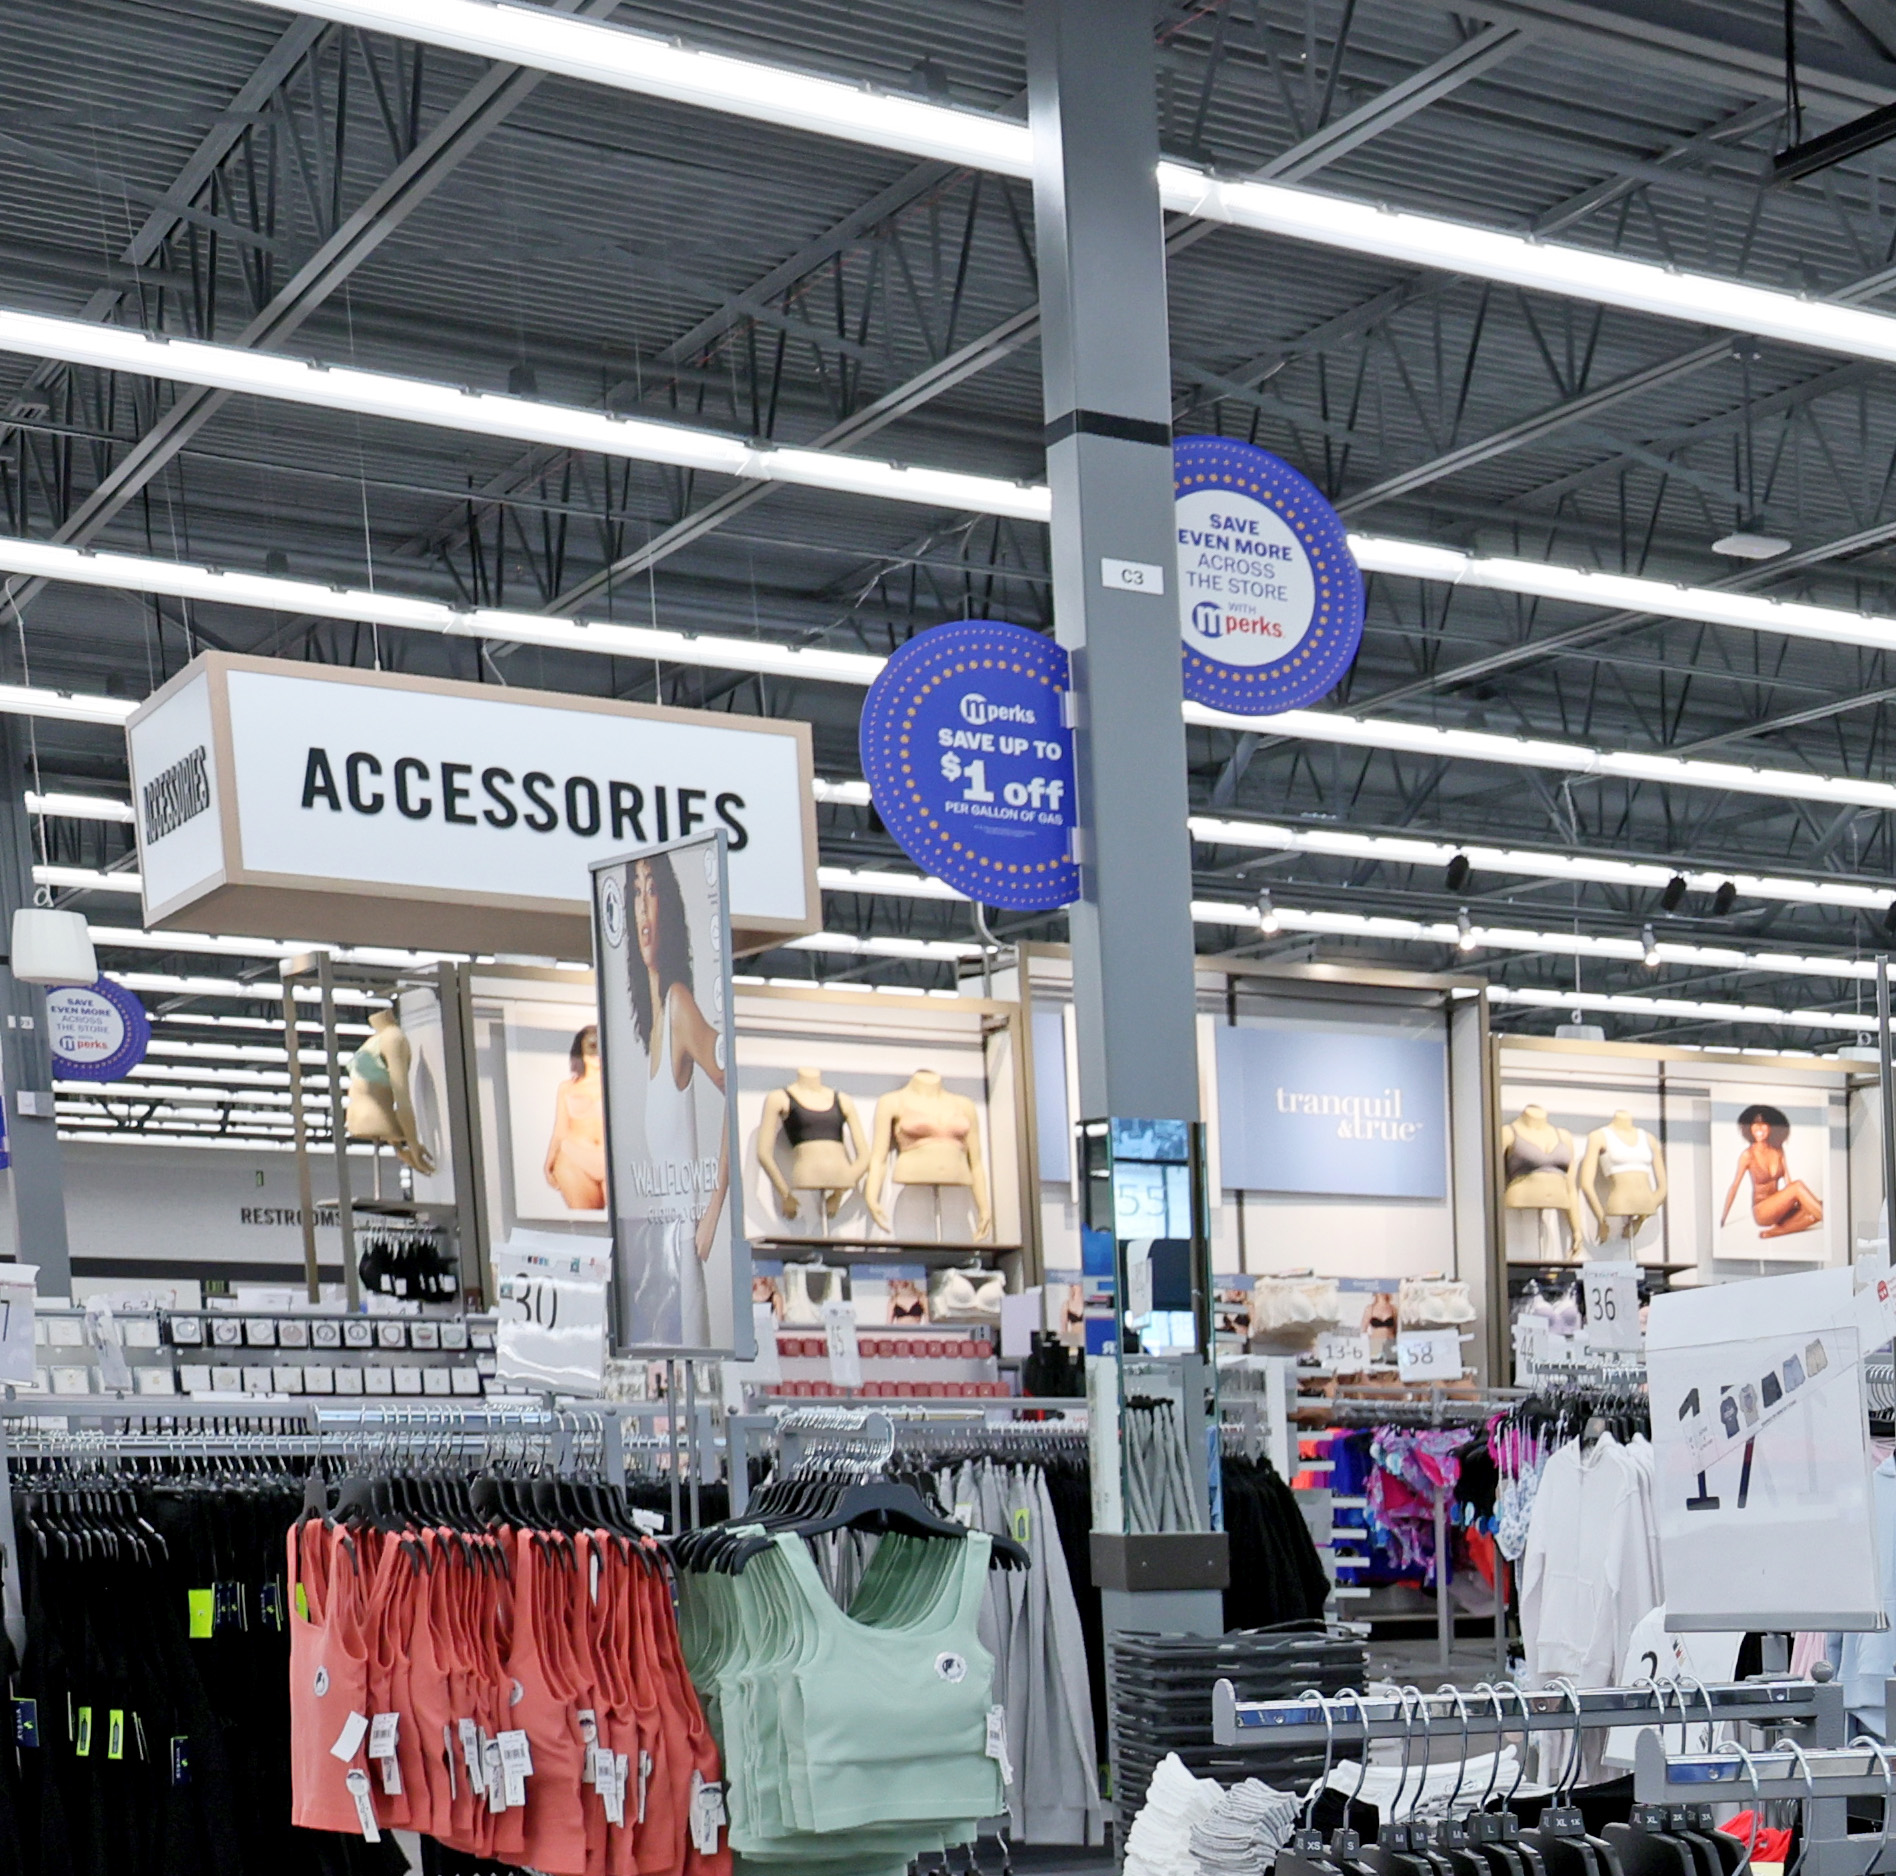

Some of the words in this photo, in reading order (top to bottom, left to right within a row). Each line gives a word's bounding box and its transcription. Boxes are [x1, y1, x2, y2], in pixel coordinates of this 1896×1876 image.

[1209, 514, 1259, 535] SAVE
[1178, 528, 1229, 550] EVEN
[1235, 538, 1293, 561] MORE
[1122, 569, 1144, 585] C3
[1198, 553, 1275, 579] ACROSS
[1186, 571, 1222, 591] THE
[1228, 578, 1288, 601] STORE
[1228, 602, 1256, 614] WITH
[938, 728, 995, 752] SAVE
[999, 736, 1029, 756] UP
[1033, 740, 1062, 761] TO
[940, 750, 994, 803] $1
[1003, 777, 1064, 810] off
[143, 745, 210, 845] ACCESSORIES
[301, 747, 749, 851] ACCESSORIES
[945, 801, 969, 814] PER
[971, 804, 1018, 821] GALLON
[1020, 810, 1036, 822] OF
[1038, 812, 1064, 826] GAS
[51, 1006, 78, 1014] EVEN
[81, 1007, 111, 1016] MORE
[67, 998, 93, 1007] SAVE
[1276, 1087, 1403, 1121] tranquil
[631, 1157, 719, 1198] WALLFLOWER
[513, 1272, 557, 1330] 30
[1592, 1288, 1616, 1321] 36
[1510, 1824, 1516, 1834] L
[1556, 1818, 1567, 1827] XL
[1647, 1816, 1658, 1825] XL
[1307, 1841, 1320, 1852] XS
[1347, 1841, 1354, 1850] S
